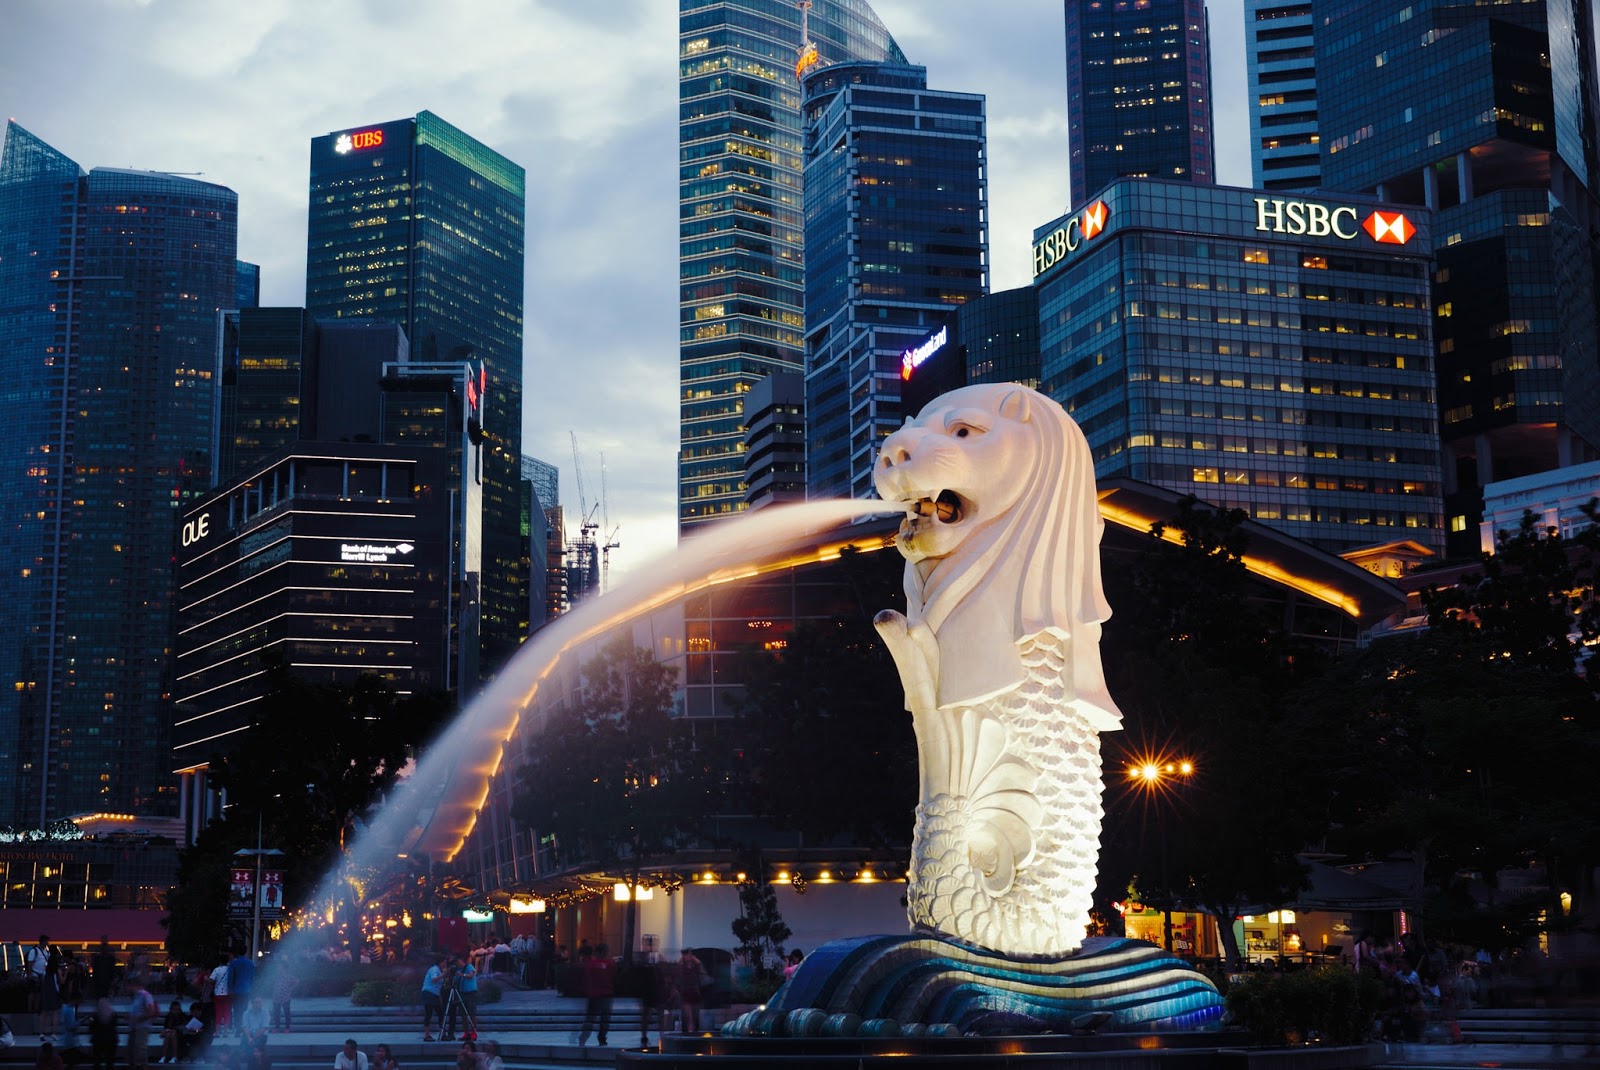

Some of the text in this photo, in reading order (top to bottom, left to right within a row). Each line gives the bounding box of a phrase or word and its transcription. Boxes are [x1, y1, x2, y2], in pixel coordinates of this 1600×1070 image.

[352, 130, 383, 149] UBS
[1254, 199, 1358, 240] HSBC
[1032, 217, 1079, 278] HSBC
[183, 513, 210, 547] OUE
[341, 544, 396, 554] Bank of America
[341, 552, 387, 562] Merrill Lynch
